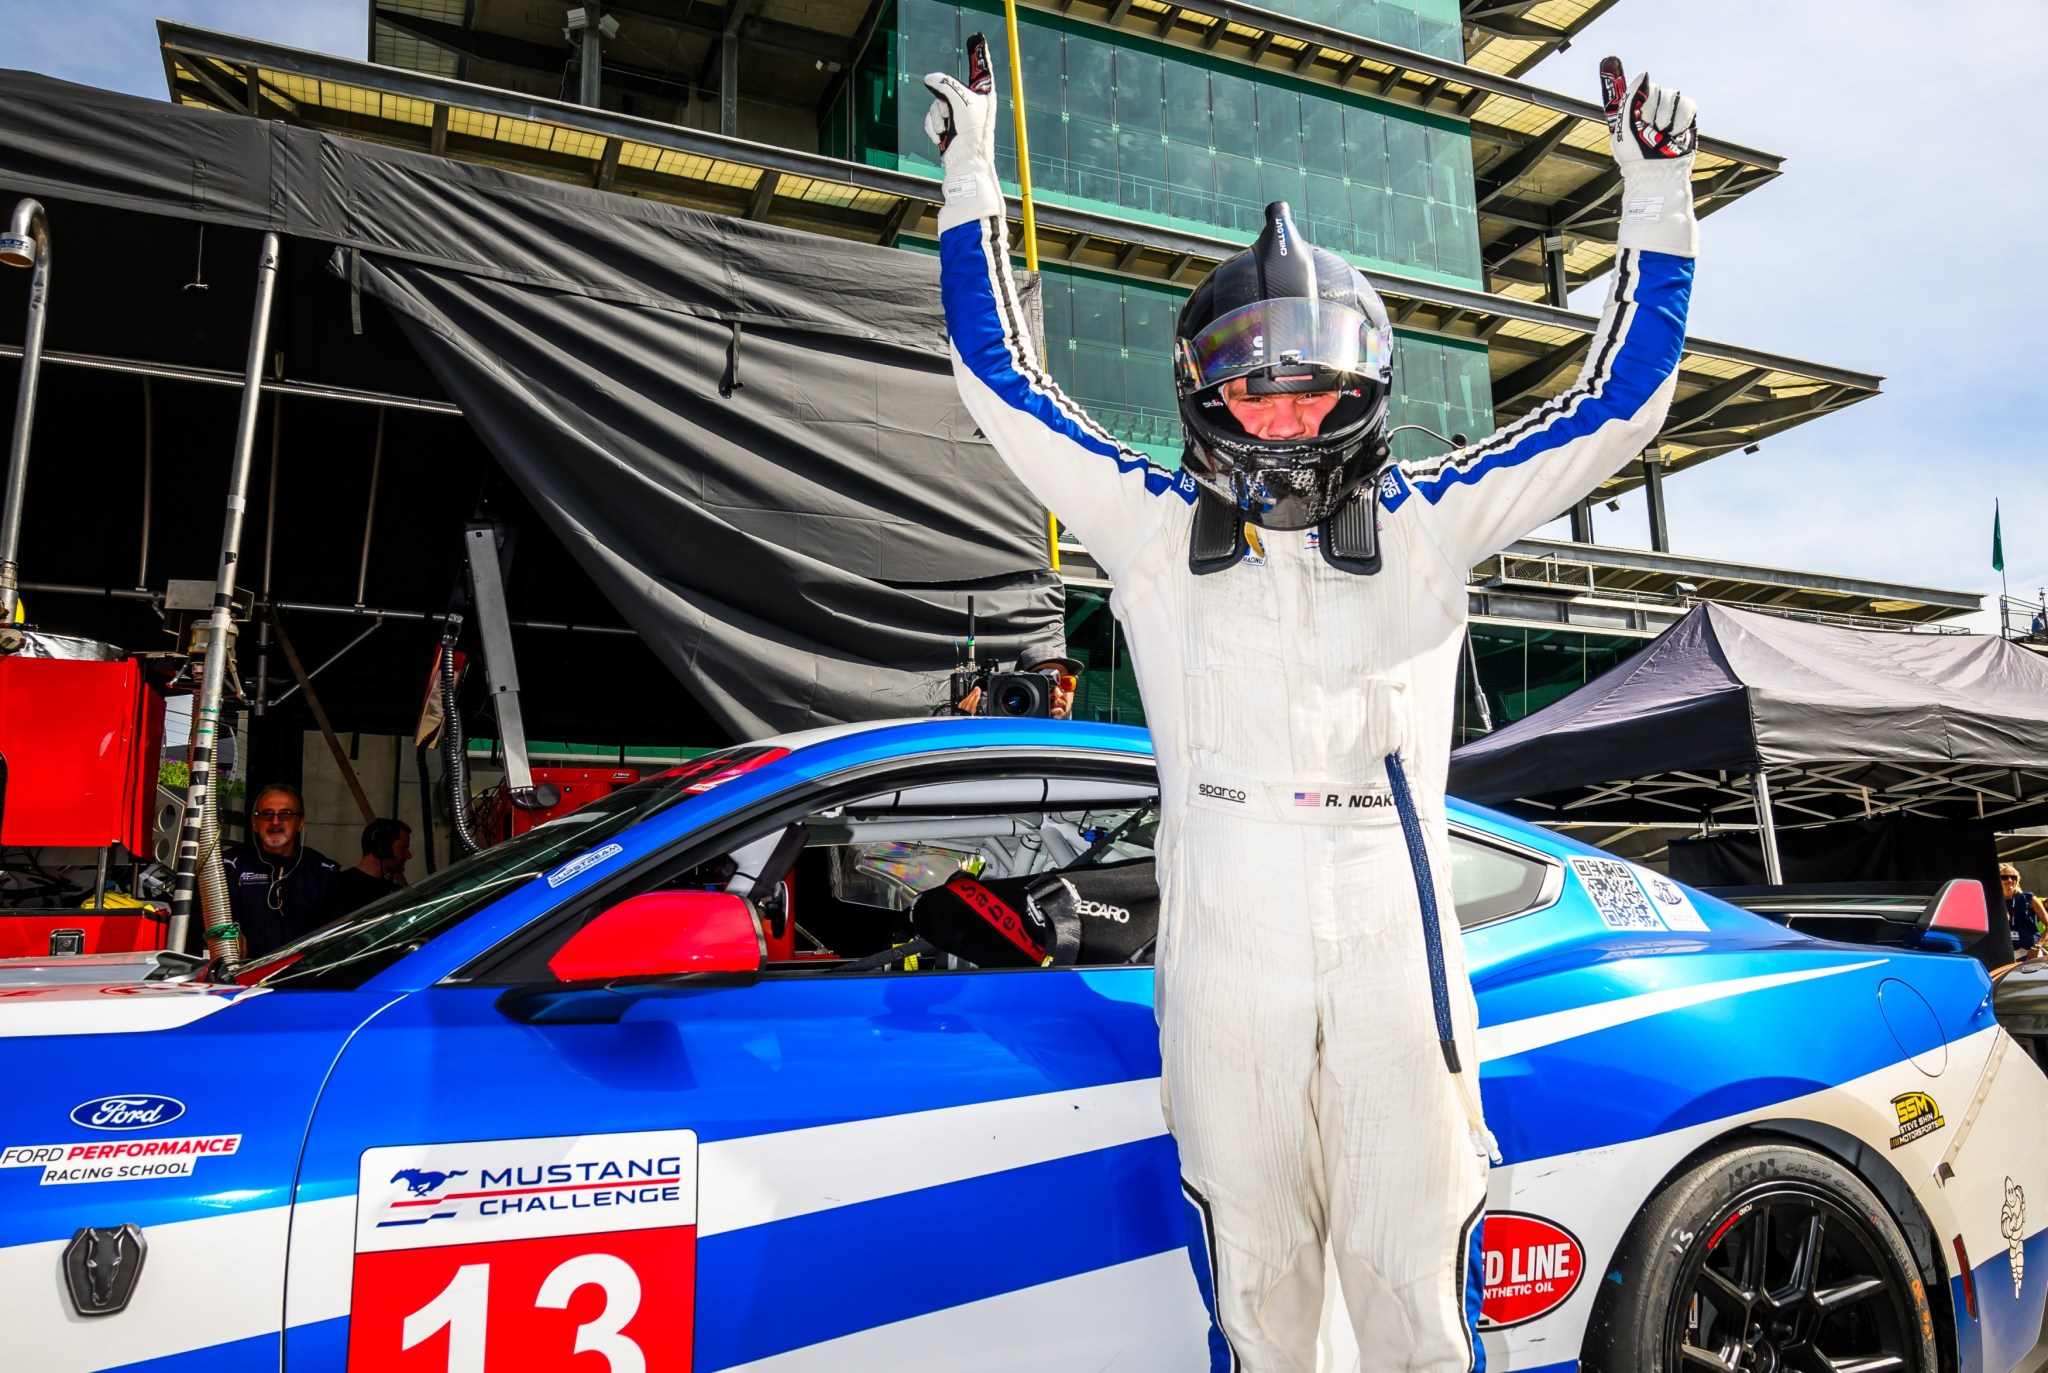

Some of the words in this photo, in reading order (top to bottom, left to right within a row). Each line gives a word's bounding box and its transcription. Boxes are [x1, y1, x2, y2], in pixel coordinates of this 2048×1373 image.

[1276, 218, 1288, 257] CHILLOUT
[1199, 783, 1246, 802] sparco
[1325, 794, 1343, 808] R.
[1349, 794, 1397, 808] NOAK
[91, 1099, 164, 1124] Ford
[1896, 1093, 1929, 1123] SSM
[1900, 1120, 1919, 1135] STEVE
[1900, 1120, 1939, 1145] MOTORSPORTS
[2, 1147, 64, 1165] FORD
[67, 1137, 238, 1161] PERFORMANCE
[44, 1166, 114, 1182] RACING
[117, 1163, 190, 1178] SCHOOL
[480, 1156, 680, 1189] MUSTANG
[1786, 1163, 1832, 1180] PILOT
[479, 1186, 680, 1216] CHALLENGE
[1511, 1243, 1571, 1284] LINE
[1483, 1284, 1532, 1299] NTHETIC
[1535, 1282, 1554, 1293] OIL
[402, 1253, 647, 1373] 13
